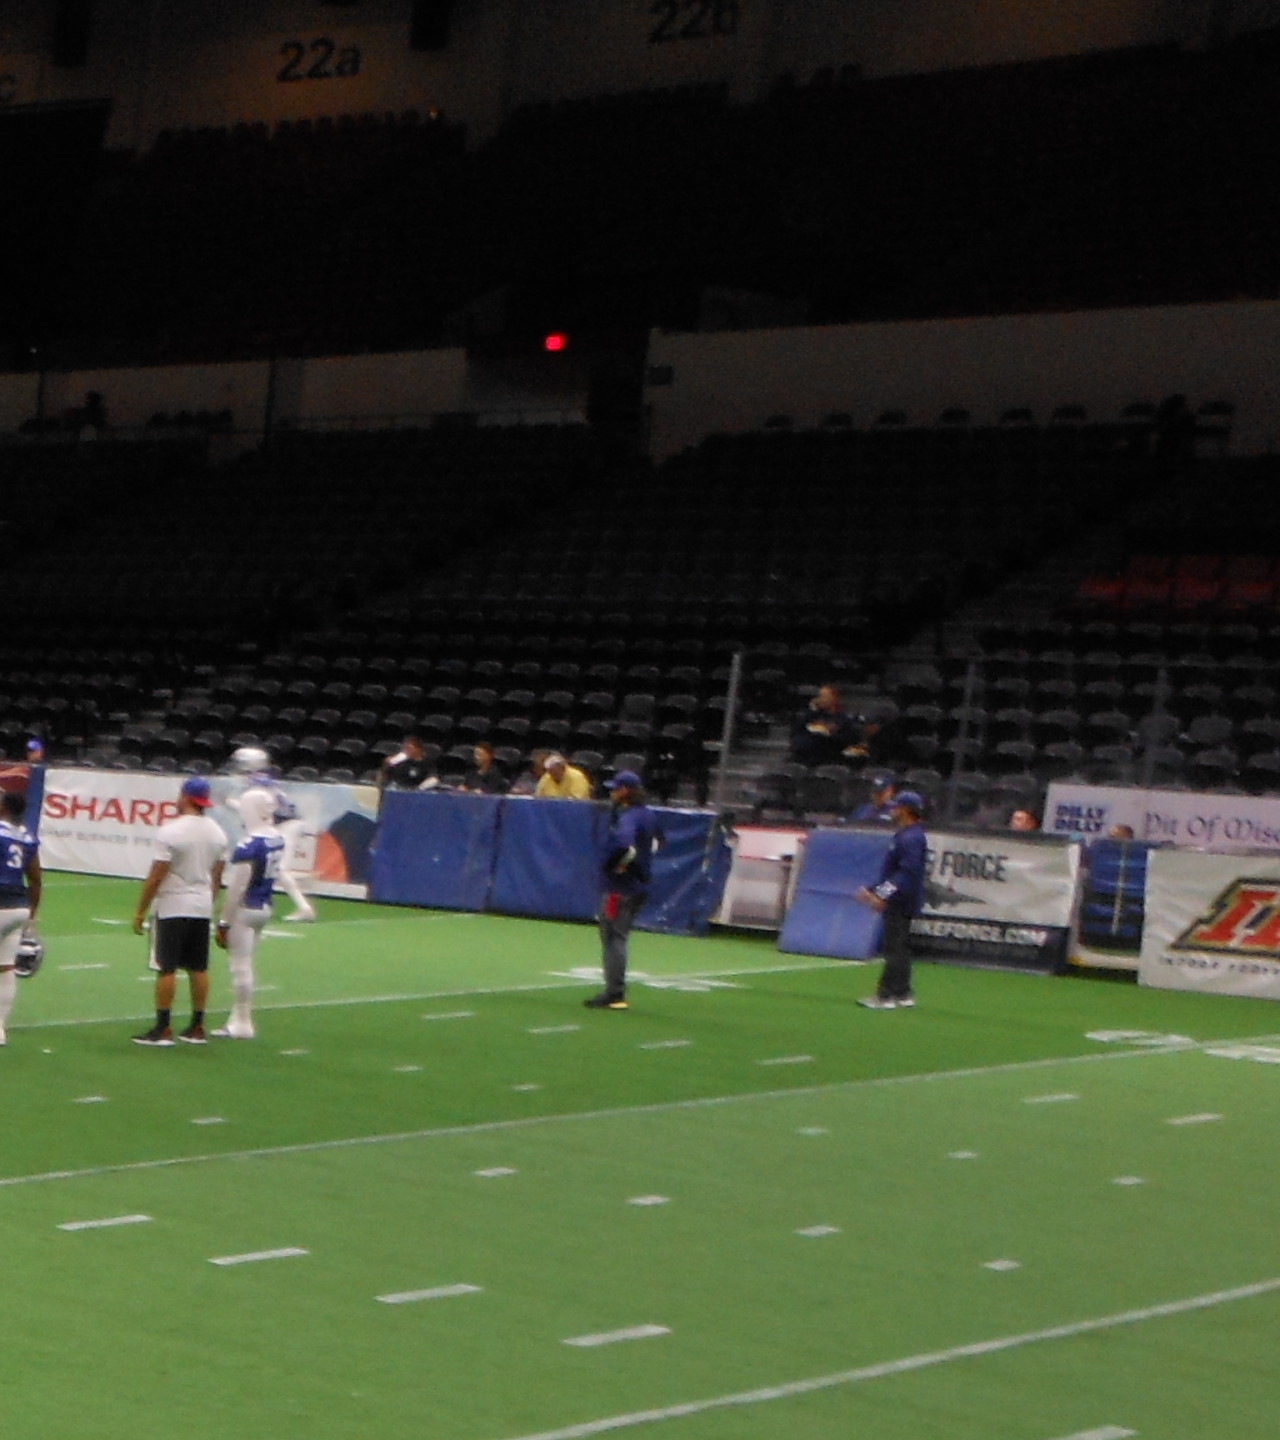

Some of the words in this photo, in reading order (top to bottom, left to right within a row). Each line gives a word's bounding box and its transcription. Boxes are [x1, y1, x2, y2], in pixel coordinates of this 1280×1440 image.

[276, 38, 362, 82] 22a
[44, 793, 179, 827] SHARP
[6, 844, 23, 869] 3
[941, 850, 1008, 882] FORCE
